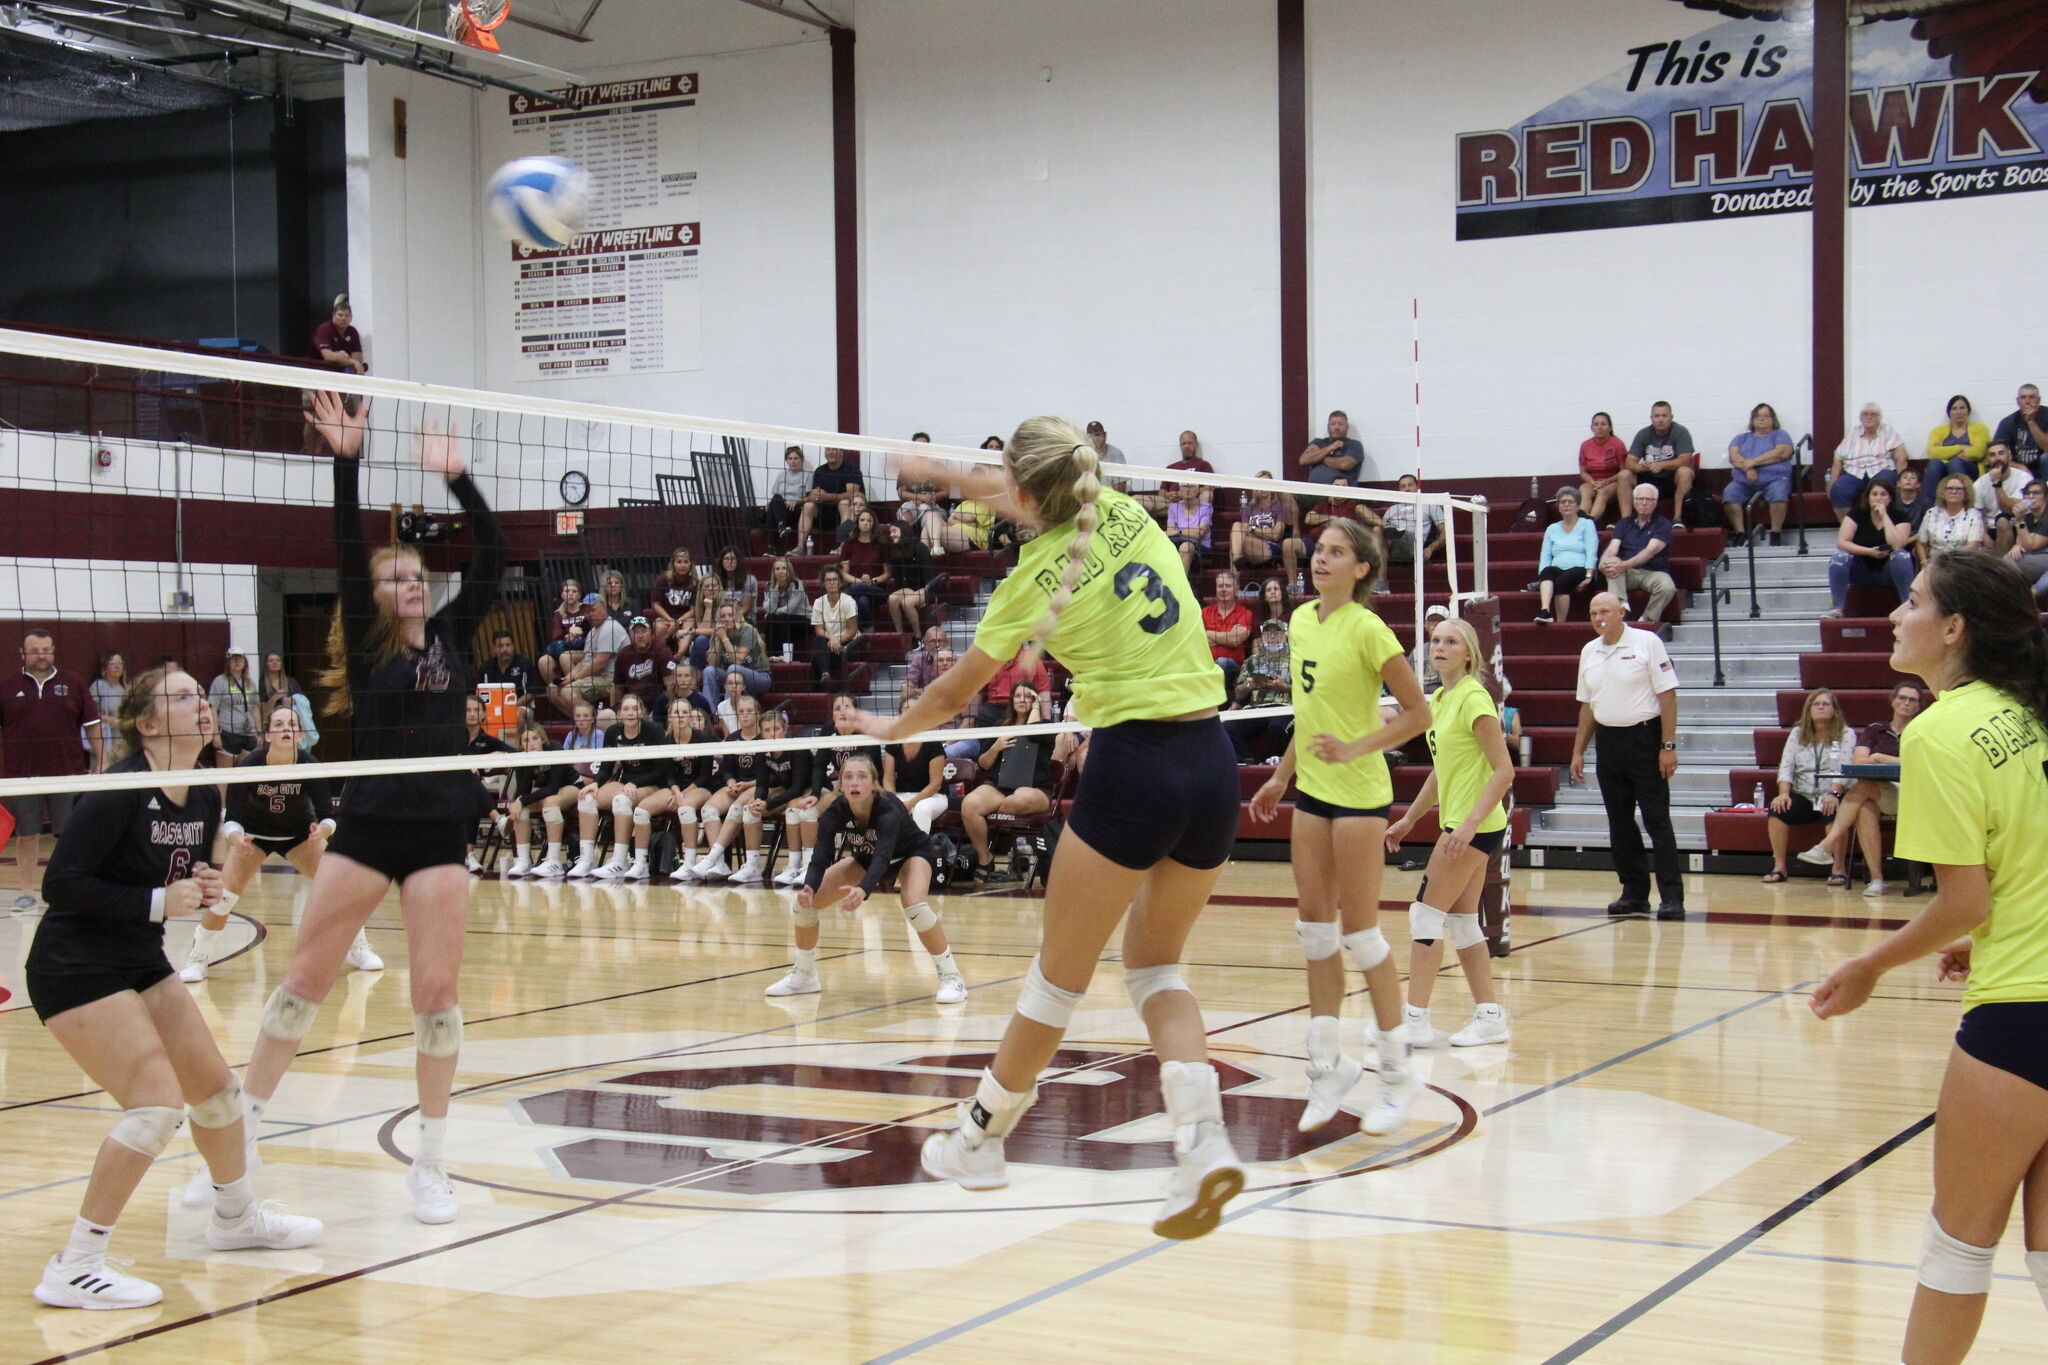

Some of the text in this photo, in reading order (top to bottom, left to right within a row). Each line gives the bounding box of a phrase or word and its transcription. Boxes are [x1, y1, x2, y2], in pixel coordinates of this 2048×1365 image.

[1625, 34, 1788, 92] This is
[599, 77, 671, 98] WRESTLING
[1456, 116, 1657, 207] RED
[1711, 186, 1812, 214] Donated
[1849, 181, 1875, 207] by
[1880, 174, 1922, 199] the
[1926, 167, 1998, 199] Sports
[571, 232, 601, 250] CITY
[602, 226, 674, 247] WRESTLING
[1114, 562, 1180, 635] 3
[1301, 660, 1317, 693] 5
[270, 795, 286, 813] 5
[165, 848, 191, 888] 6
